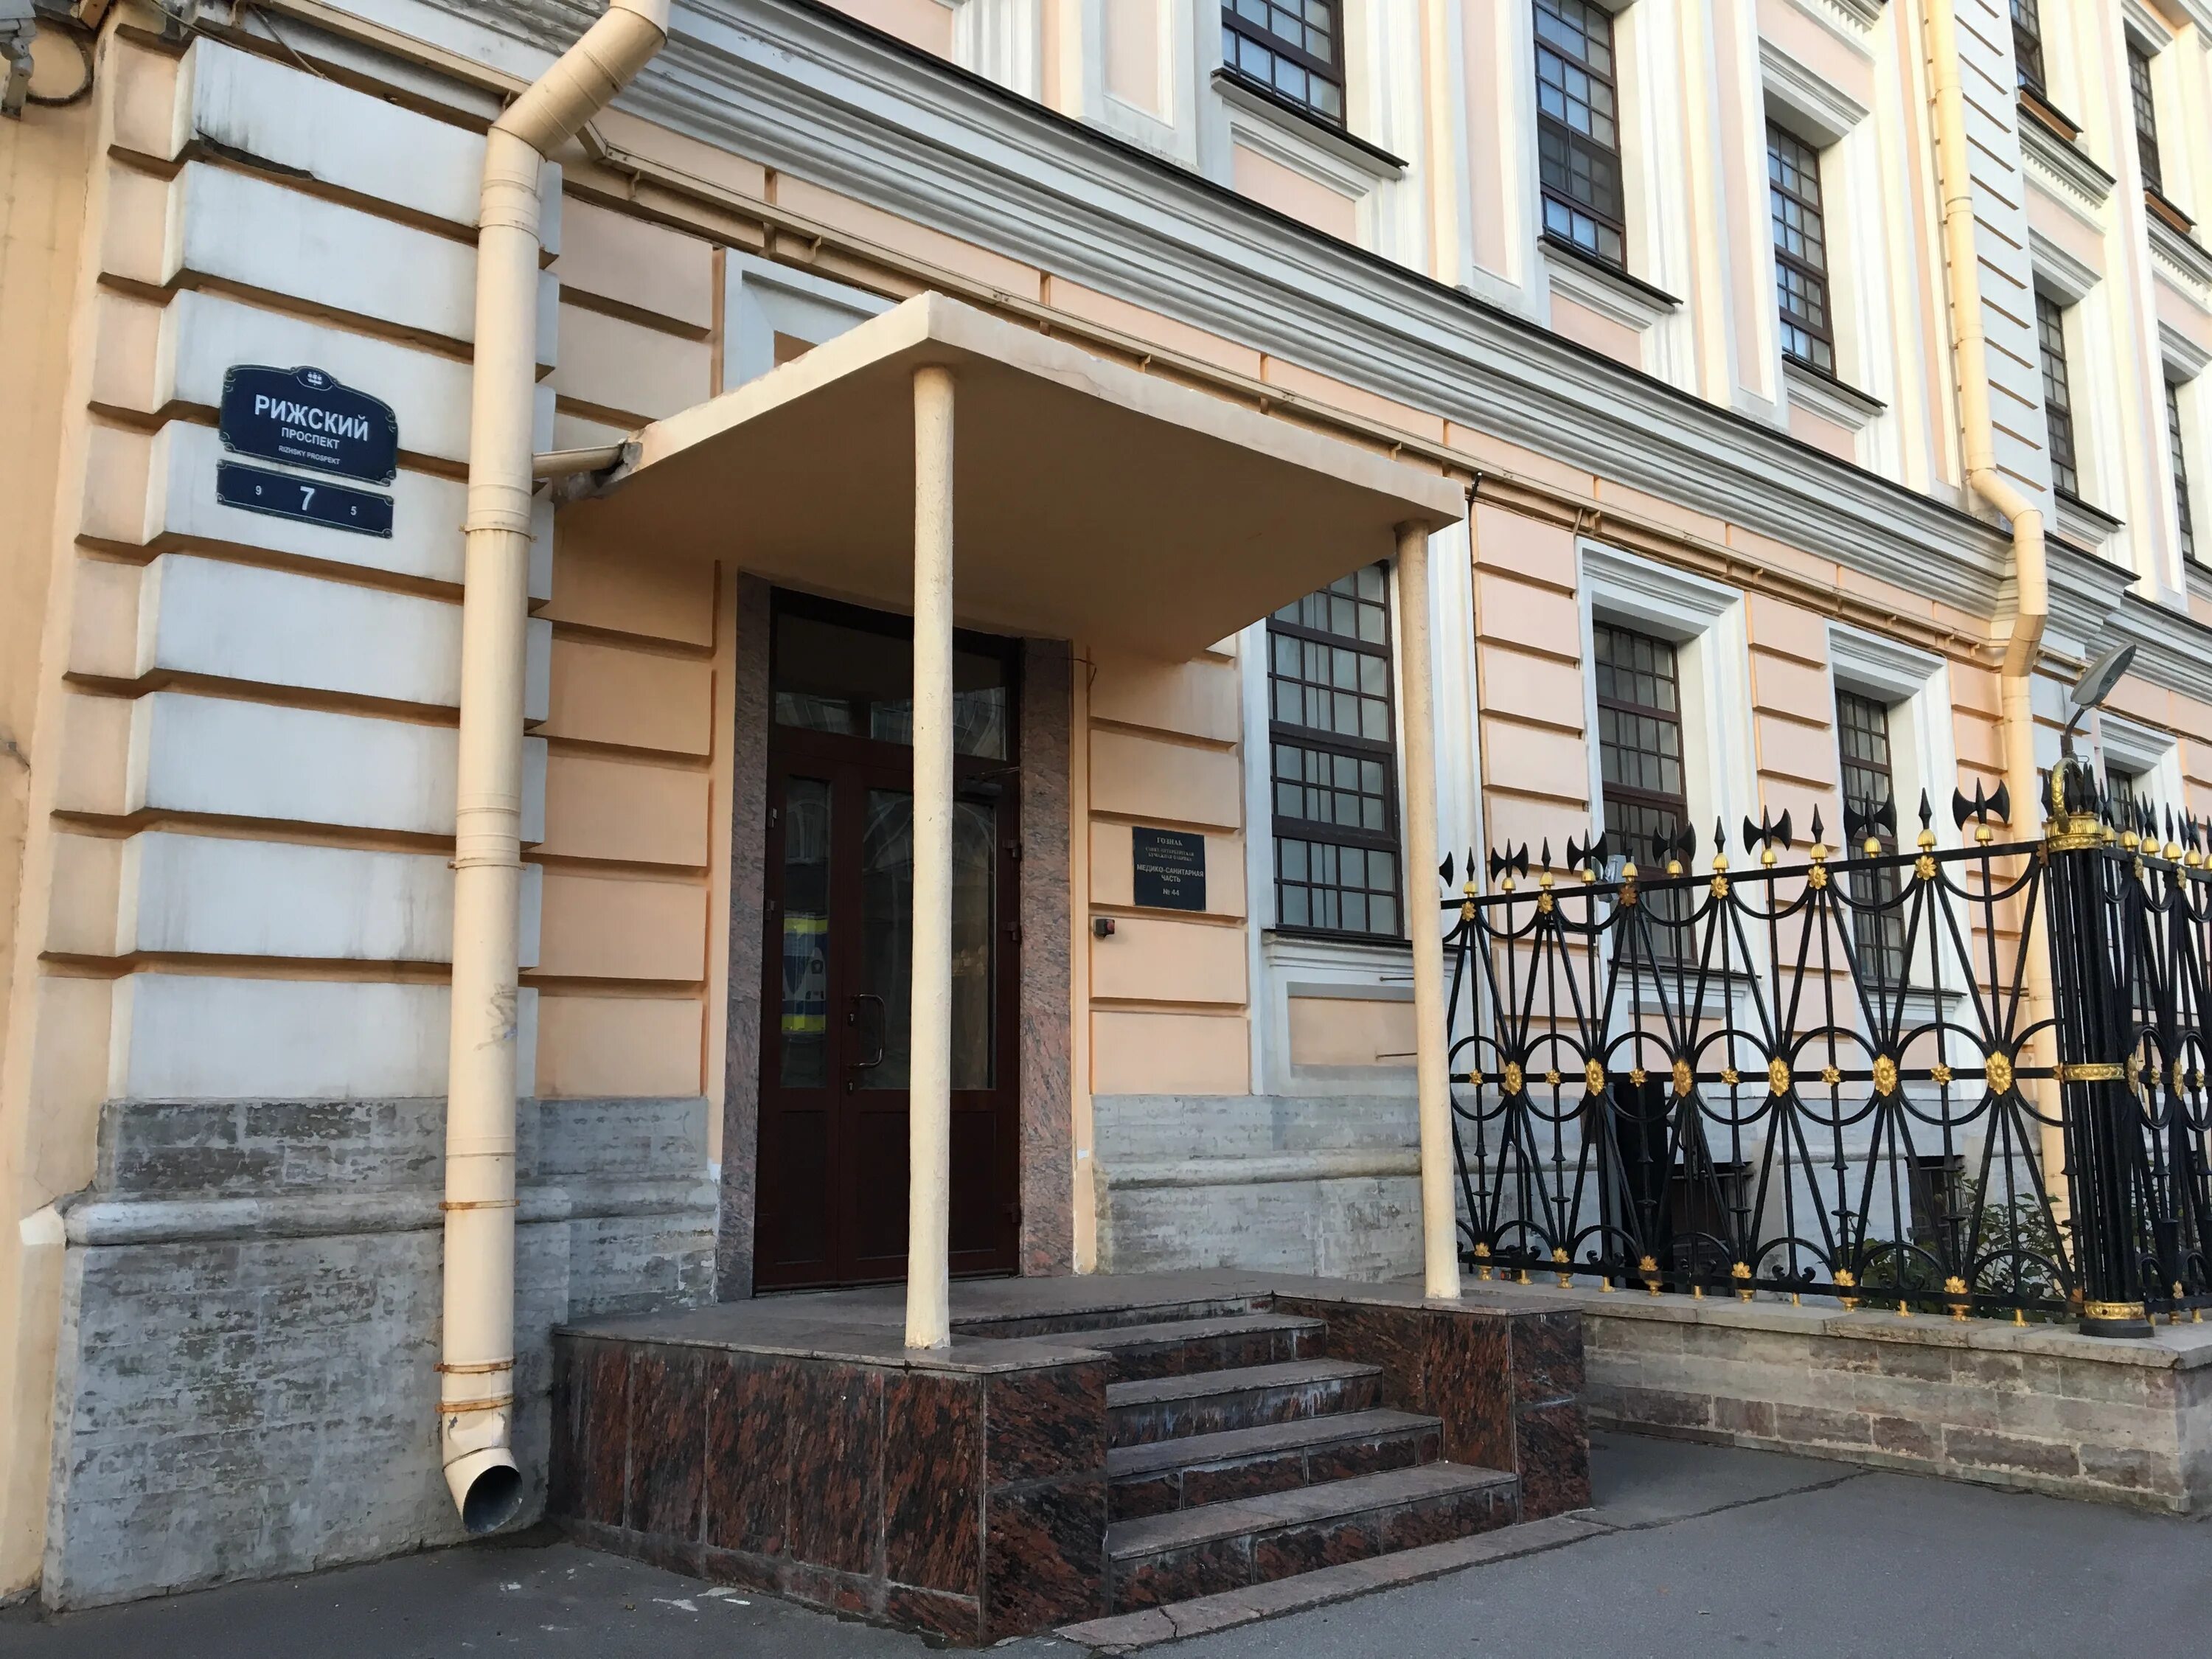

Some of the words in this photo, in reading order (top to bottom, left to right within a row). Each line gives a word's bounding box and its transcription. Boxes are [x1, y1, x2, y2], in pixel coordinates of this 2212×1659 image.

[254, 394, 369, 442] РИЖСКИЙ
[281, 427, 340, 449] ПРОСПЕКТ
[278, 445, 306, 457] RIZHSKY
[307, 452, 341, 465] PROSPEKT
[255, 485, 262, 495] 9
[300, 486, 315, 511] 7
[350, 506, 357, 516] 5
[1156, 837, 1183, 846] ГОЗНАК
[1136, 863, 1204, 877] МЕДИКО-САНИТАРНАЯ
[1161, 874, 1181, 883] ЧАСТЬ
